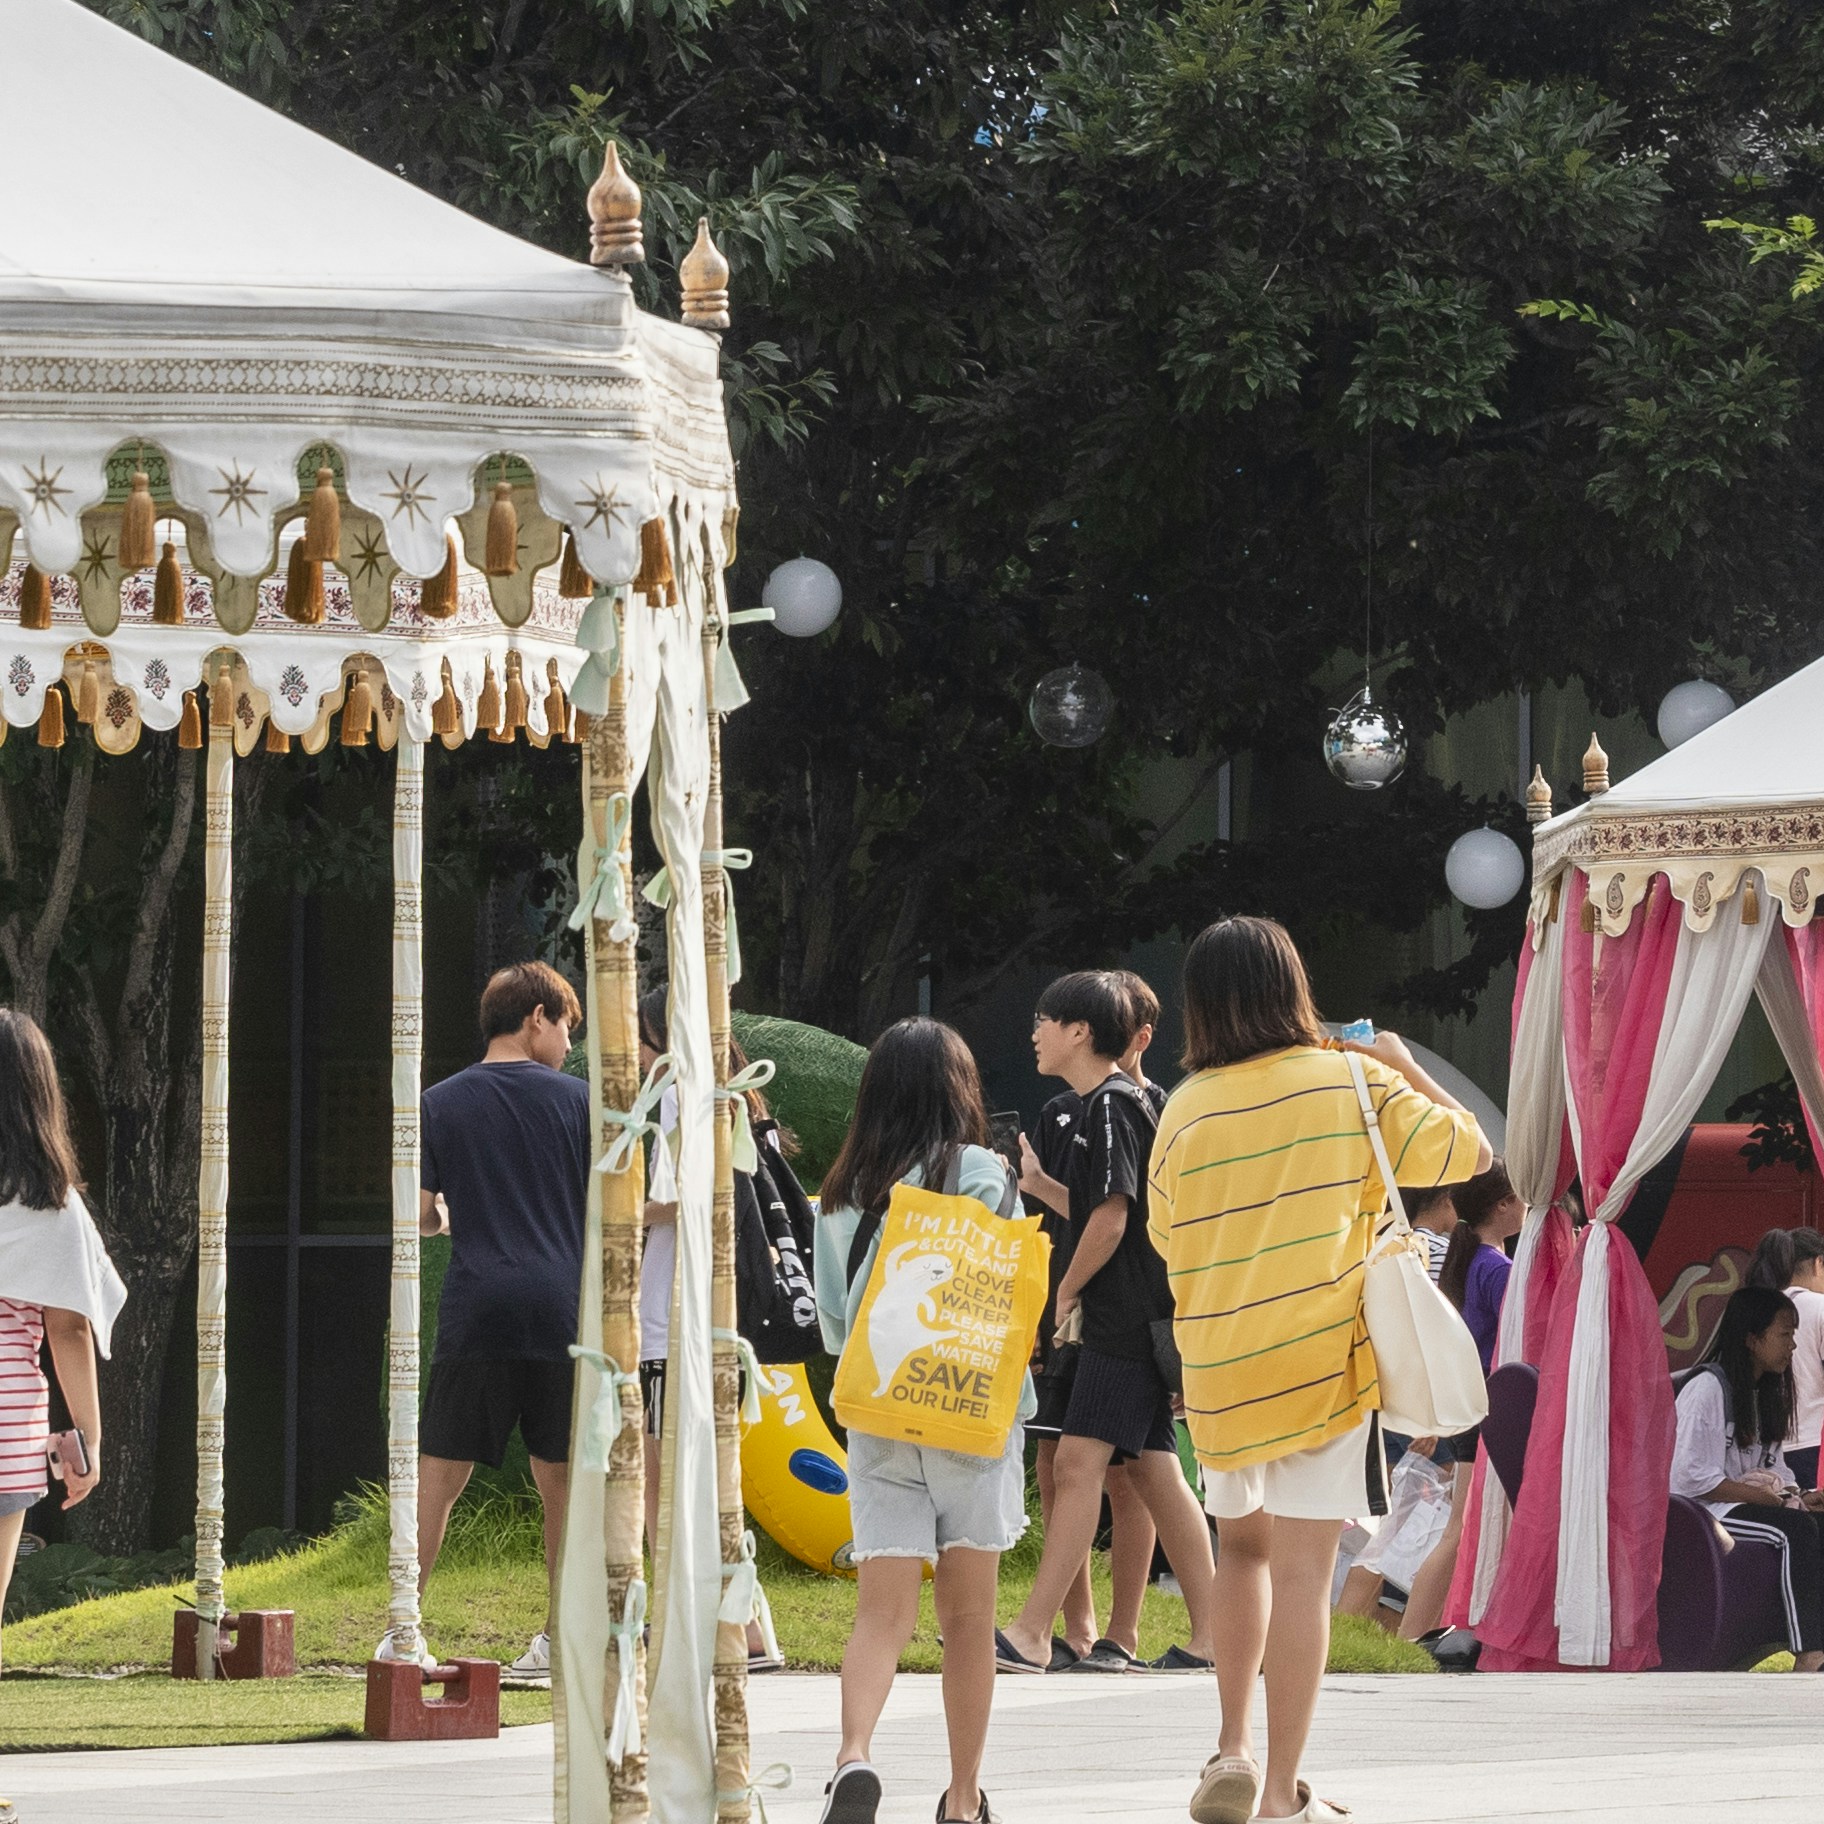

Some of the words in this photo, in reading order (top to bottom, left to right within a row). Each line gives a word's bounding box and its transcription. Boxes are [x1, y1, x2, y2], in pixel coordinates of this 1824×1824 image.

[904, 1210, 942, 1235] I'M
[946, 1217, 1023, 1260] LITTLE
[956, 1258, 963, 1273] I
[965, 1264, 1016, 1294] LOVE
[980, 1255, 1019, 1277] AND
[952, 1277, 1014, 1311] CLEAN
[939, 1308, 1009, 1339] PLEASE
[931, 1341, 1000, 1373] WATER!
[959, 1331, 1005, 1355] SAVE
[905, 1356, 994, 1400] SAVE
[891, 1384, 939, 1409] OUR
[940, 1394, 989, 1420] LIFE!
